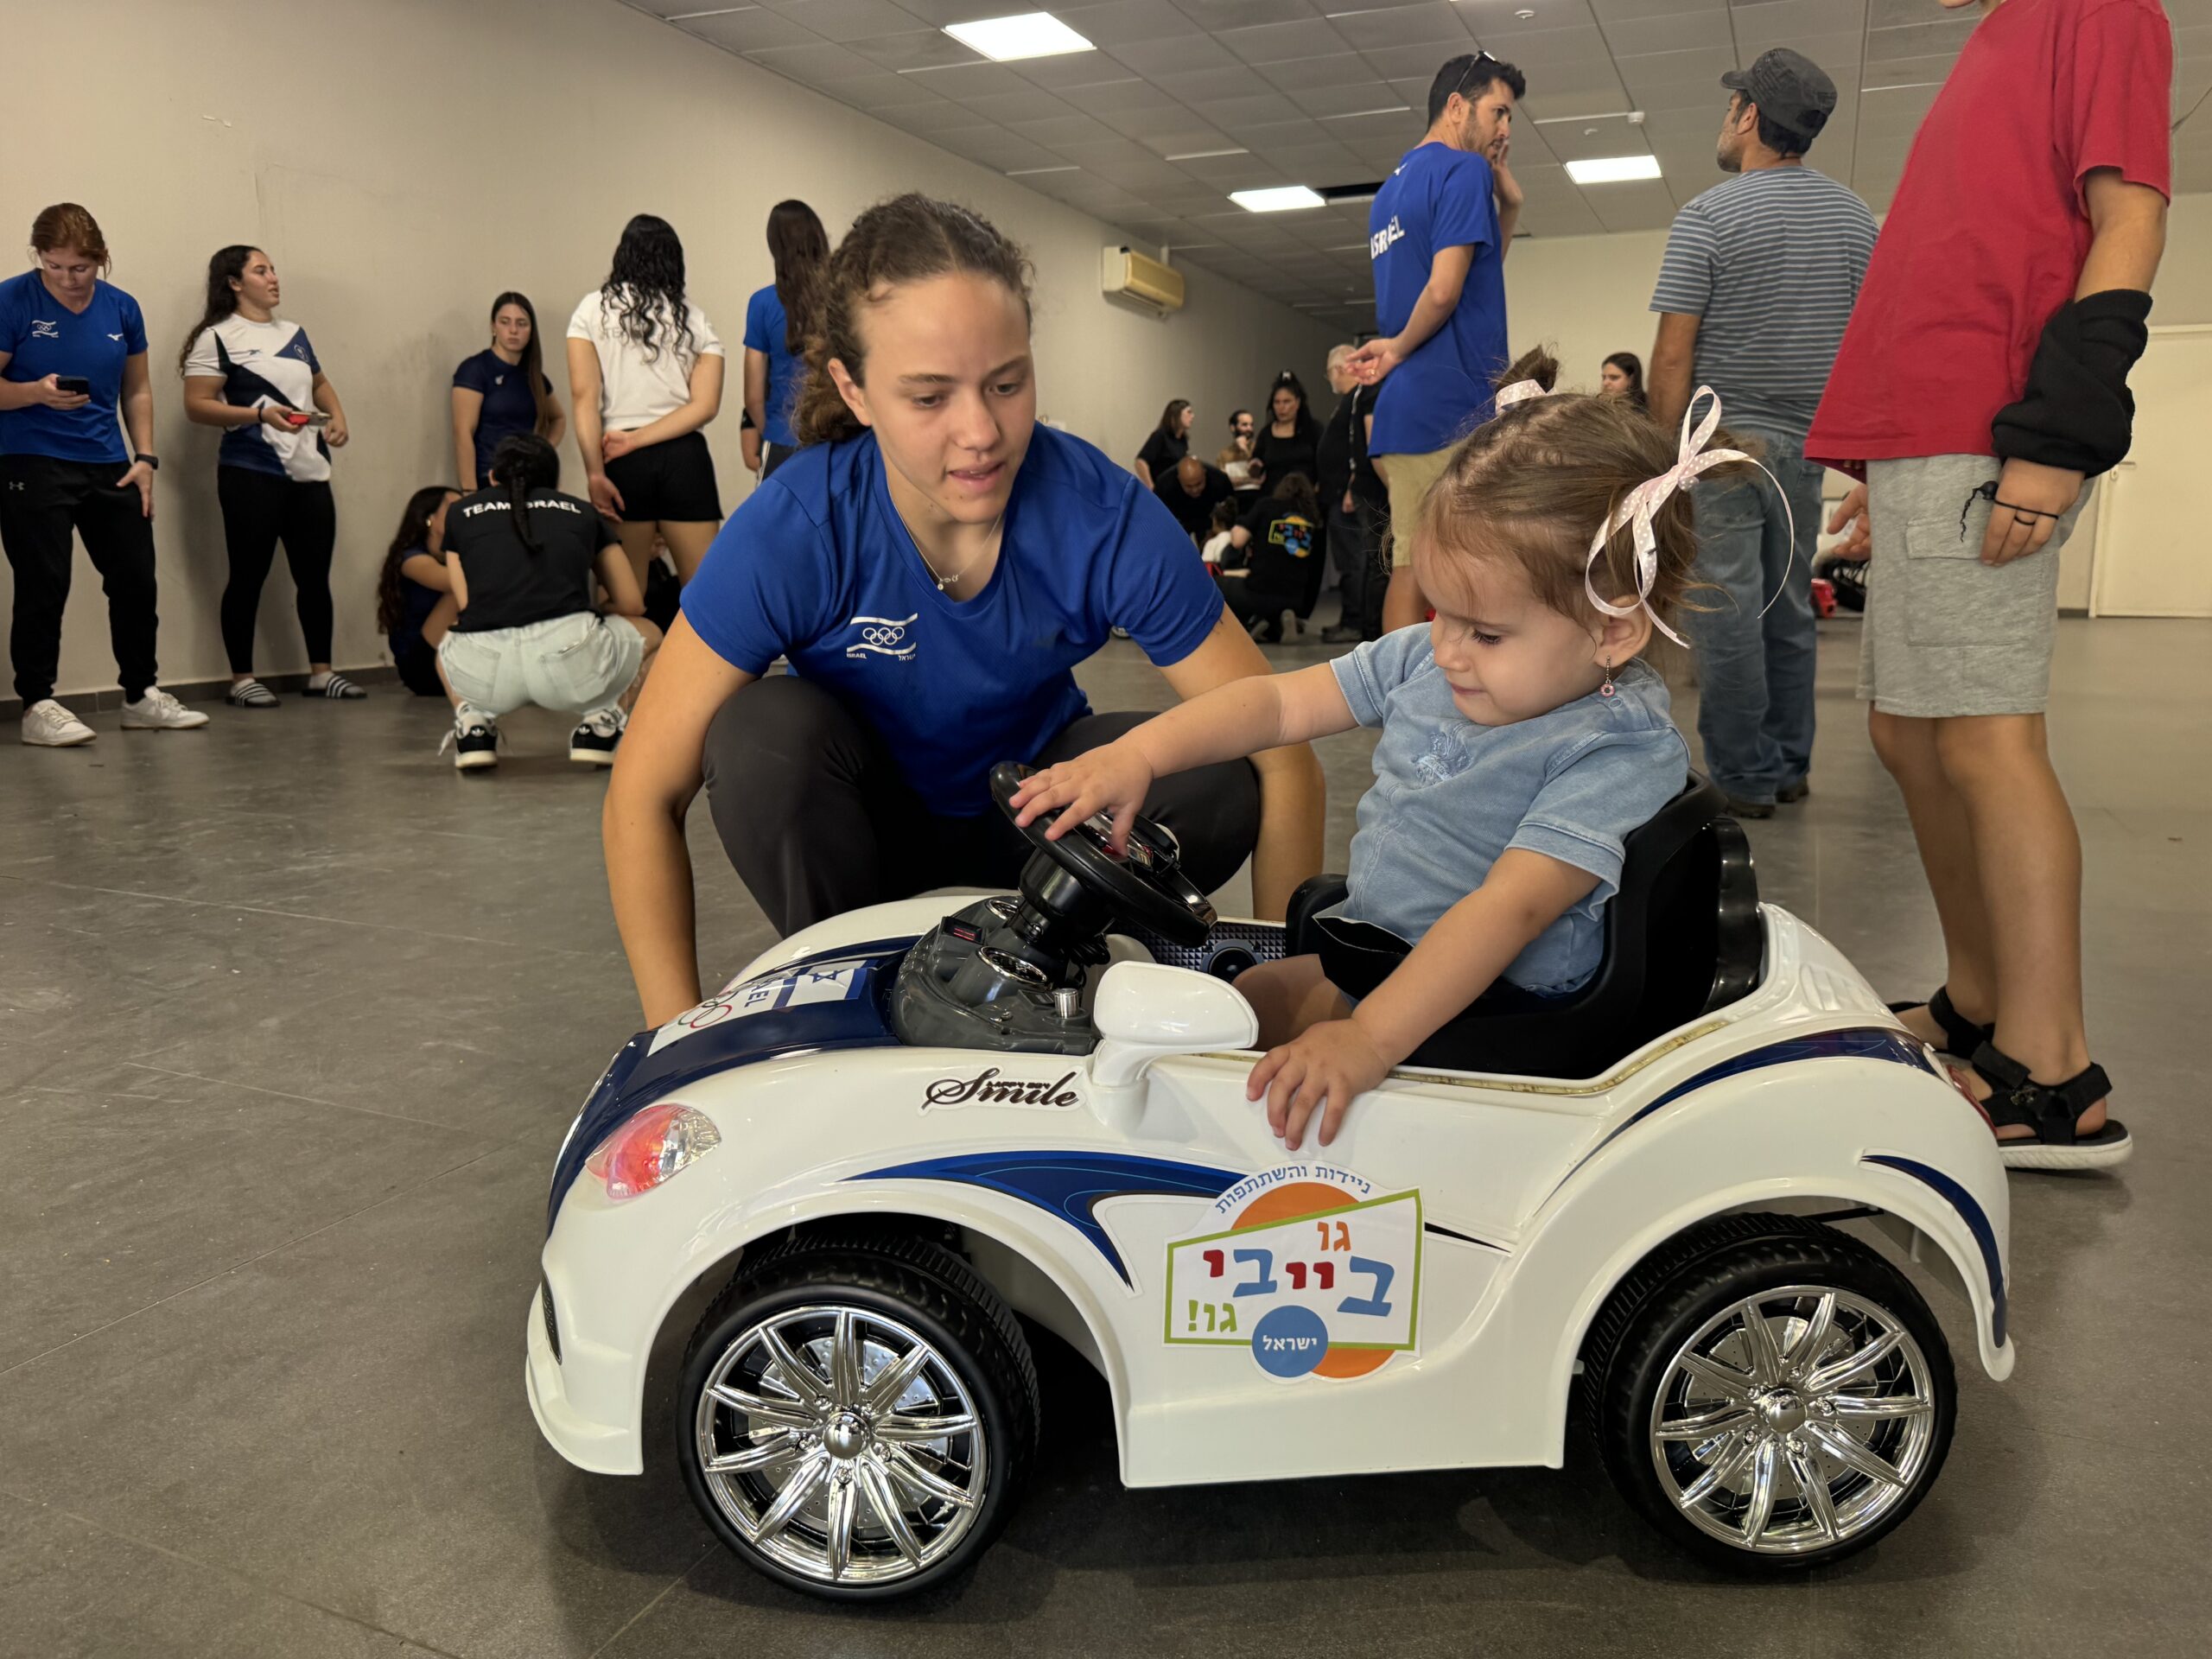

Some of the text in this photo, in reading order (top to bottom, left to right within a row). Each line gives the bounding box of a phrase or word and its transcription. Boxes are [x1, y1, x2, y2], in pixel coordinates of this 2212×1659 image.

[1370, 215, 1405, 259] ISREL
[463, 501, 511, 518] TEAM
[921, 1067, 1079, 1109] Smile
[1215, 1166, 1372, 1214] ניידות והשתתפות
[1317, 1220, 1351, 1252] גו
[1203, 1249, 1395, 1317] בייבי
[1187, 1299, 1237, 1332] גו!
[1262, 1335, 1318, 1351] ישראל
